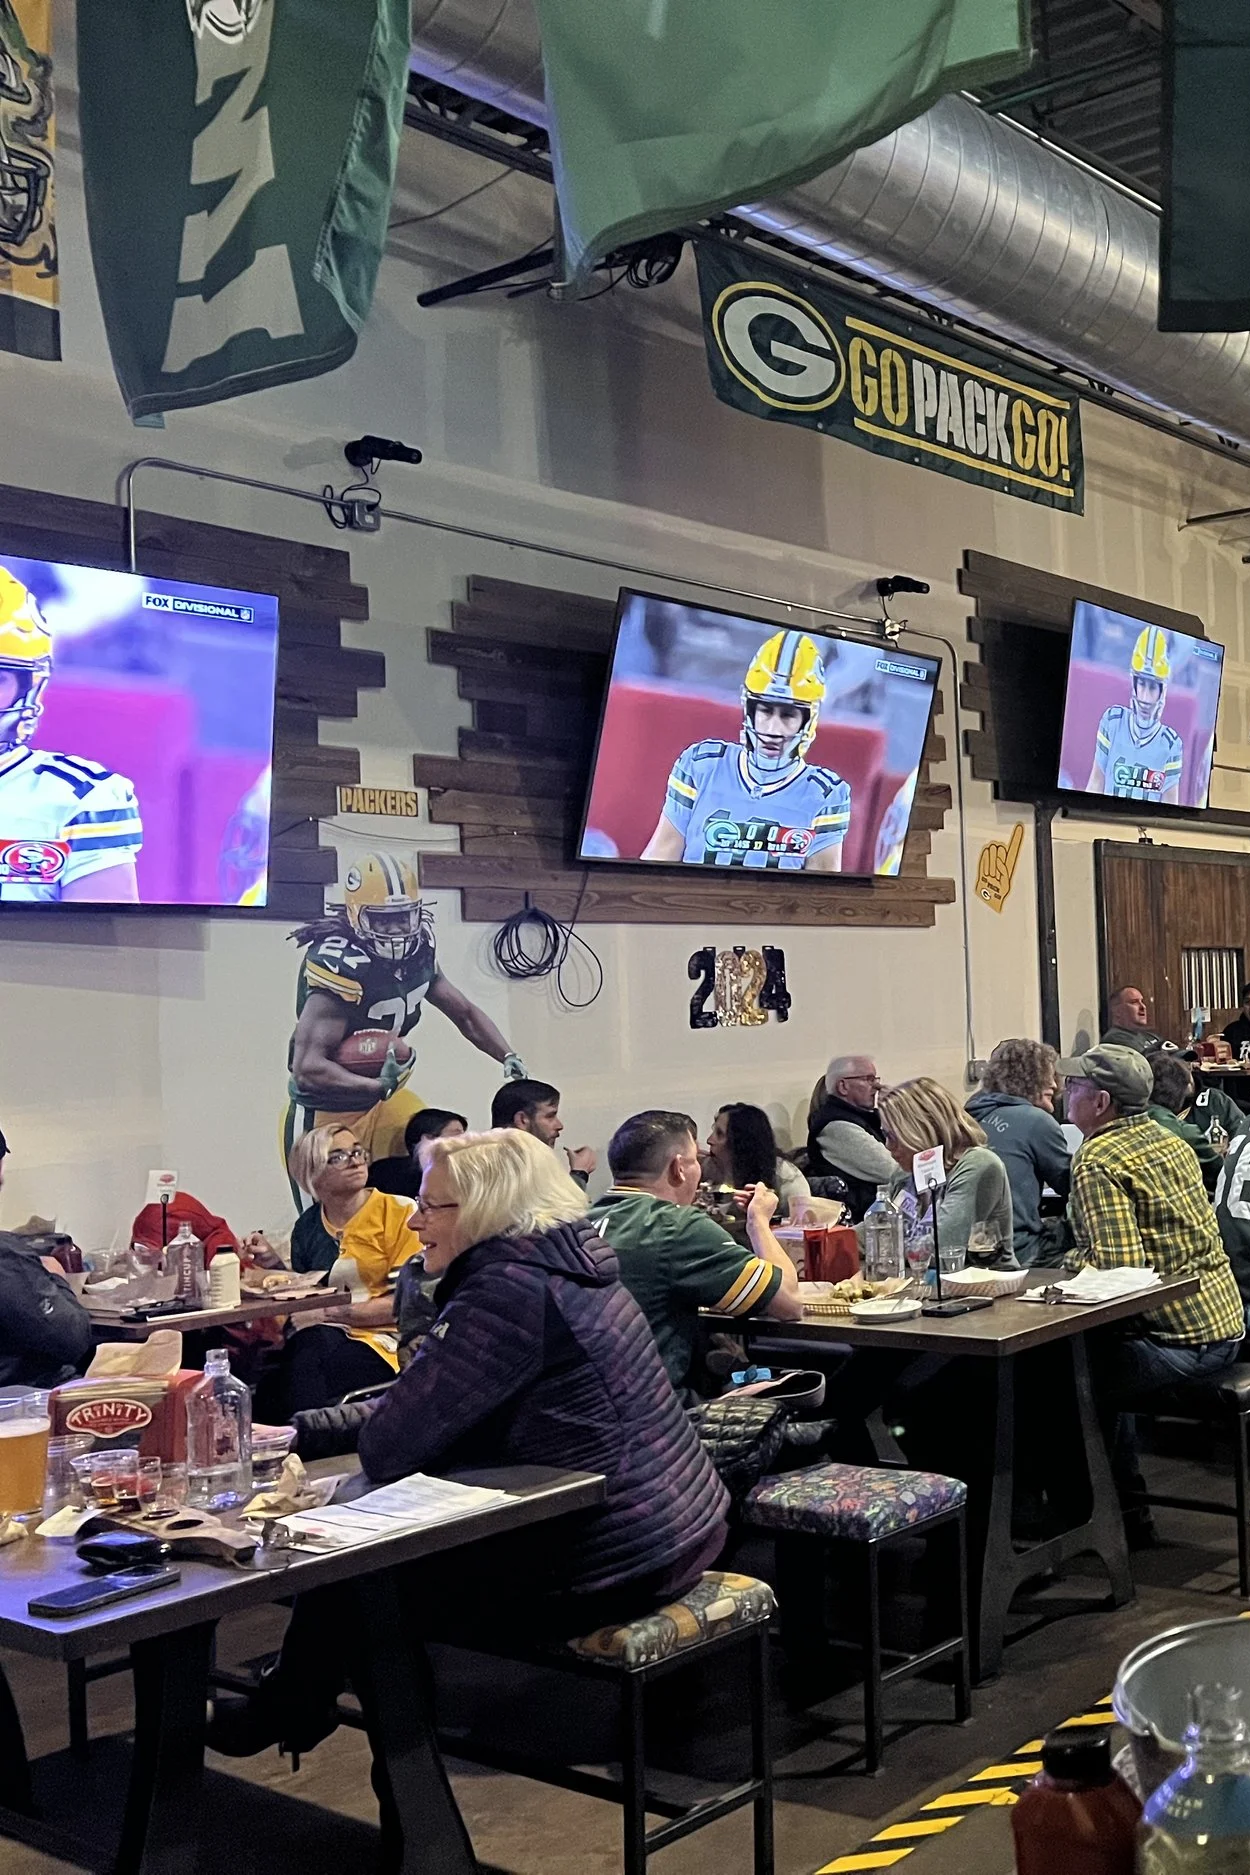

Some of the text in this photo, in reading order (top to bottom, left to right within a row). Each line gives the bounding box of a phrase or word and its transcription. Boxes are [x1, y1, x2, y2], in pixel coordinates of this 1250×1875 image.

[849, 337, 1071, 482] GO PACK GO!
[146, 595, 239, 618] FOX DIVISIONAL
[341, 787, 418, 817] PACKERS
[688, 947, 791, 1029] 2024
[71, 1402, 148, 1426] TRINITY
